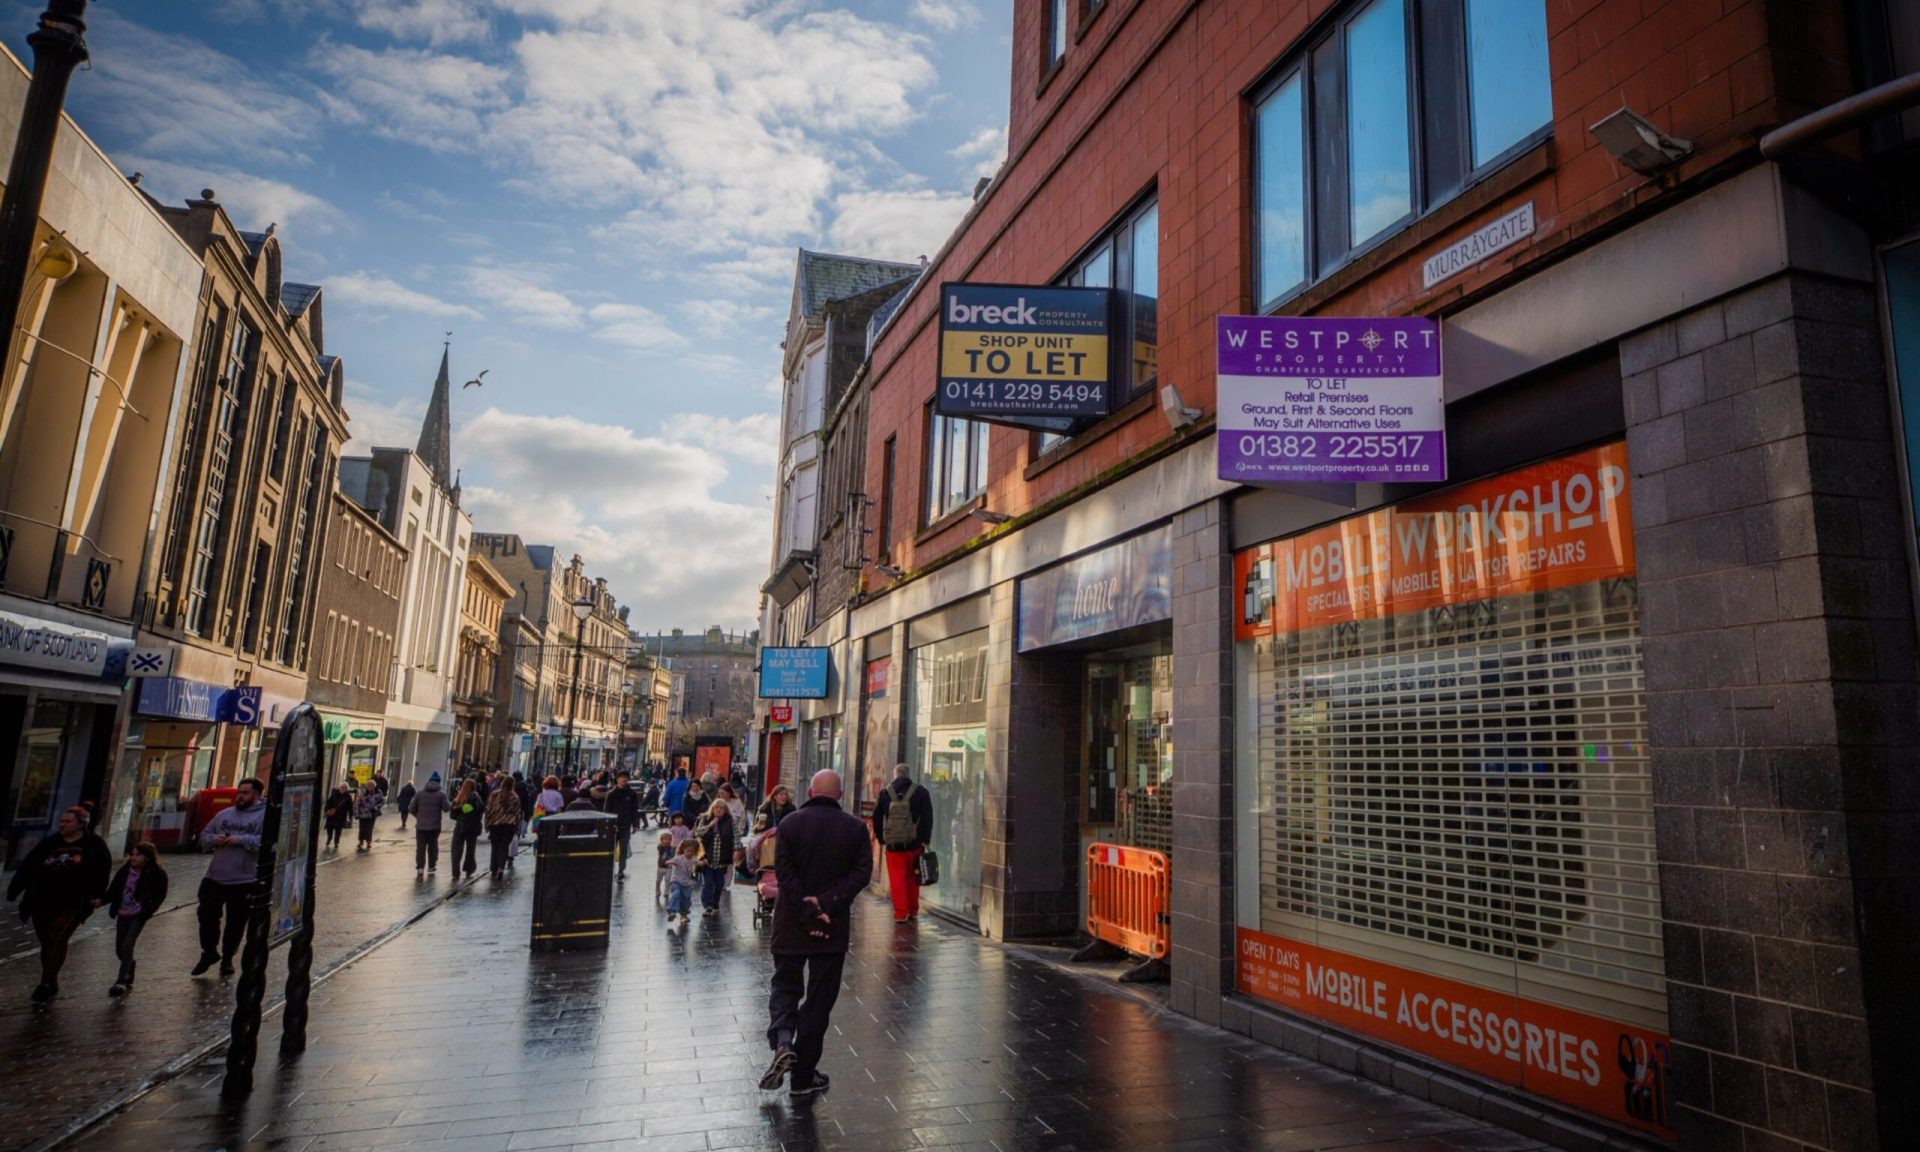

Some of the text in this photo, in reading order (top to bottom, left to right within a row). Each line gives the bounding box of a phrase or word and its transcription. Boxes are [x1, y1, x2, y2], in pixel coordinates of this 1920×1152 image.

[1428, 210, 1528, 282] MURRAYGATE
[949, 295, 1038, 325] breck
[1039, 311, 1087, 319] PROPERTY
[1039, 319, 1104, 328] CONSULTANTS
[979, 335, 1074, 349] SHOP UNIT
[965, 349, 1087, 376] TO LET
[1255, 354, 1405, 363] PROPERTY
[1255, 366, 1406, 374] CHARTERED SURVEYORS
[1306, 378, 1347, 390] TO LET
[946, 381, 1103, 402] 0141 229 5494
[1284, 392, 1369, 403] Retail Premises
[970, 400, 1078, 410] brecksutherland.com
[1242, 404, 1413, 416] Ground, First & Second Floors
[1254, 418, 1401, 430] May Suit Alternative Uses
[1239, 435, 1424, 458] 01382 225517
[1268, 463, 1389, 474] www.westportproperty.co.uk
[1307, 584, 1370, 613] SPECIALISTS
[1459, 557, 1509, 583] LAPTOP
[1516, 541, 1586, 572] REPAIRS
[1073, 563, 1117, 621] home
[0, 623, 97, 662] ANK OF SCOTLAND
[774, 649, 788, 658] TO
[769, 659, 819, 668] MAY SELL
[166, 678, 209, 718] WHSmith
[234, 695, 256, 723] S
[1242, 939, 1300, 970] OPEN 7 DAYS
[1397, 990, 1600, 1087] ACCESSORIES
